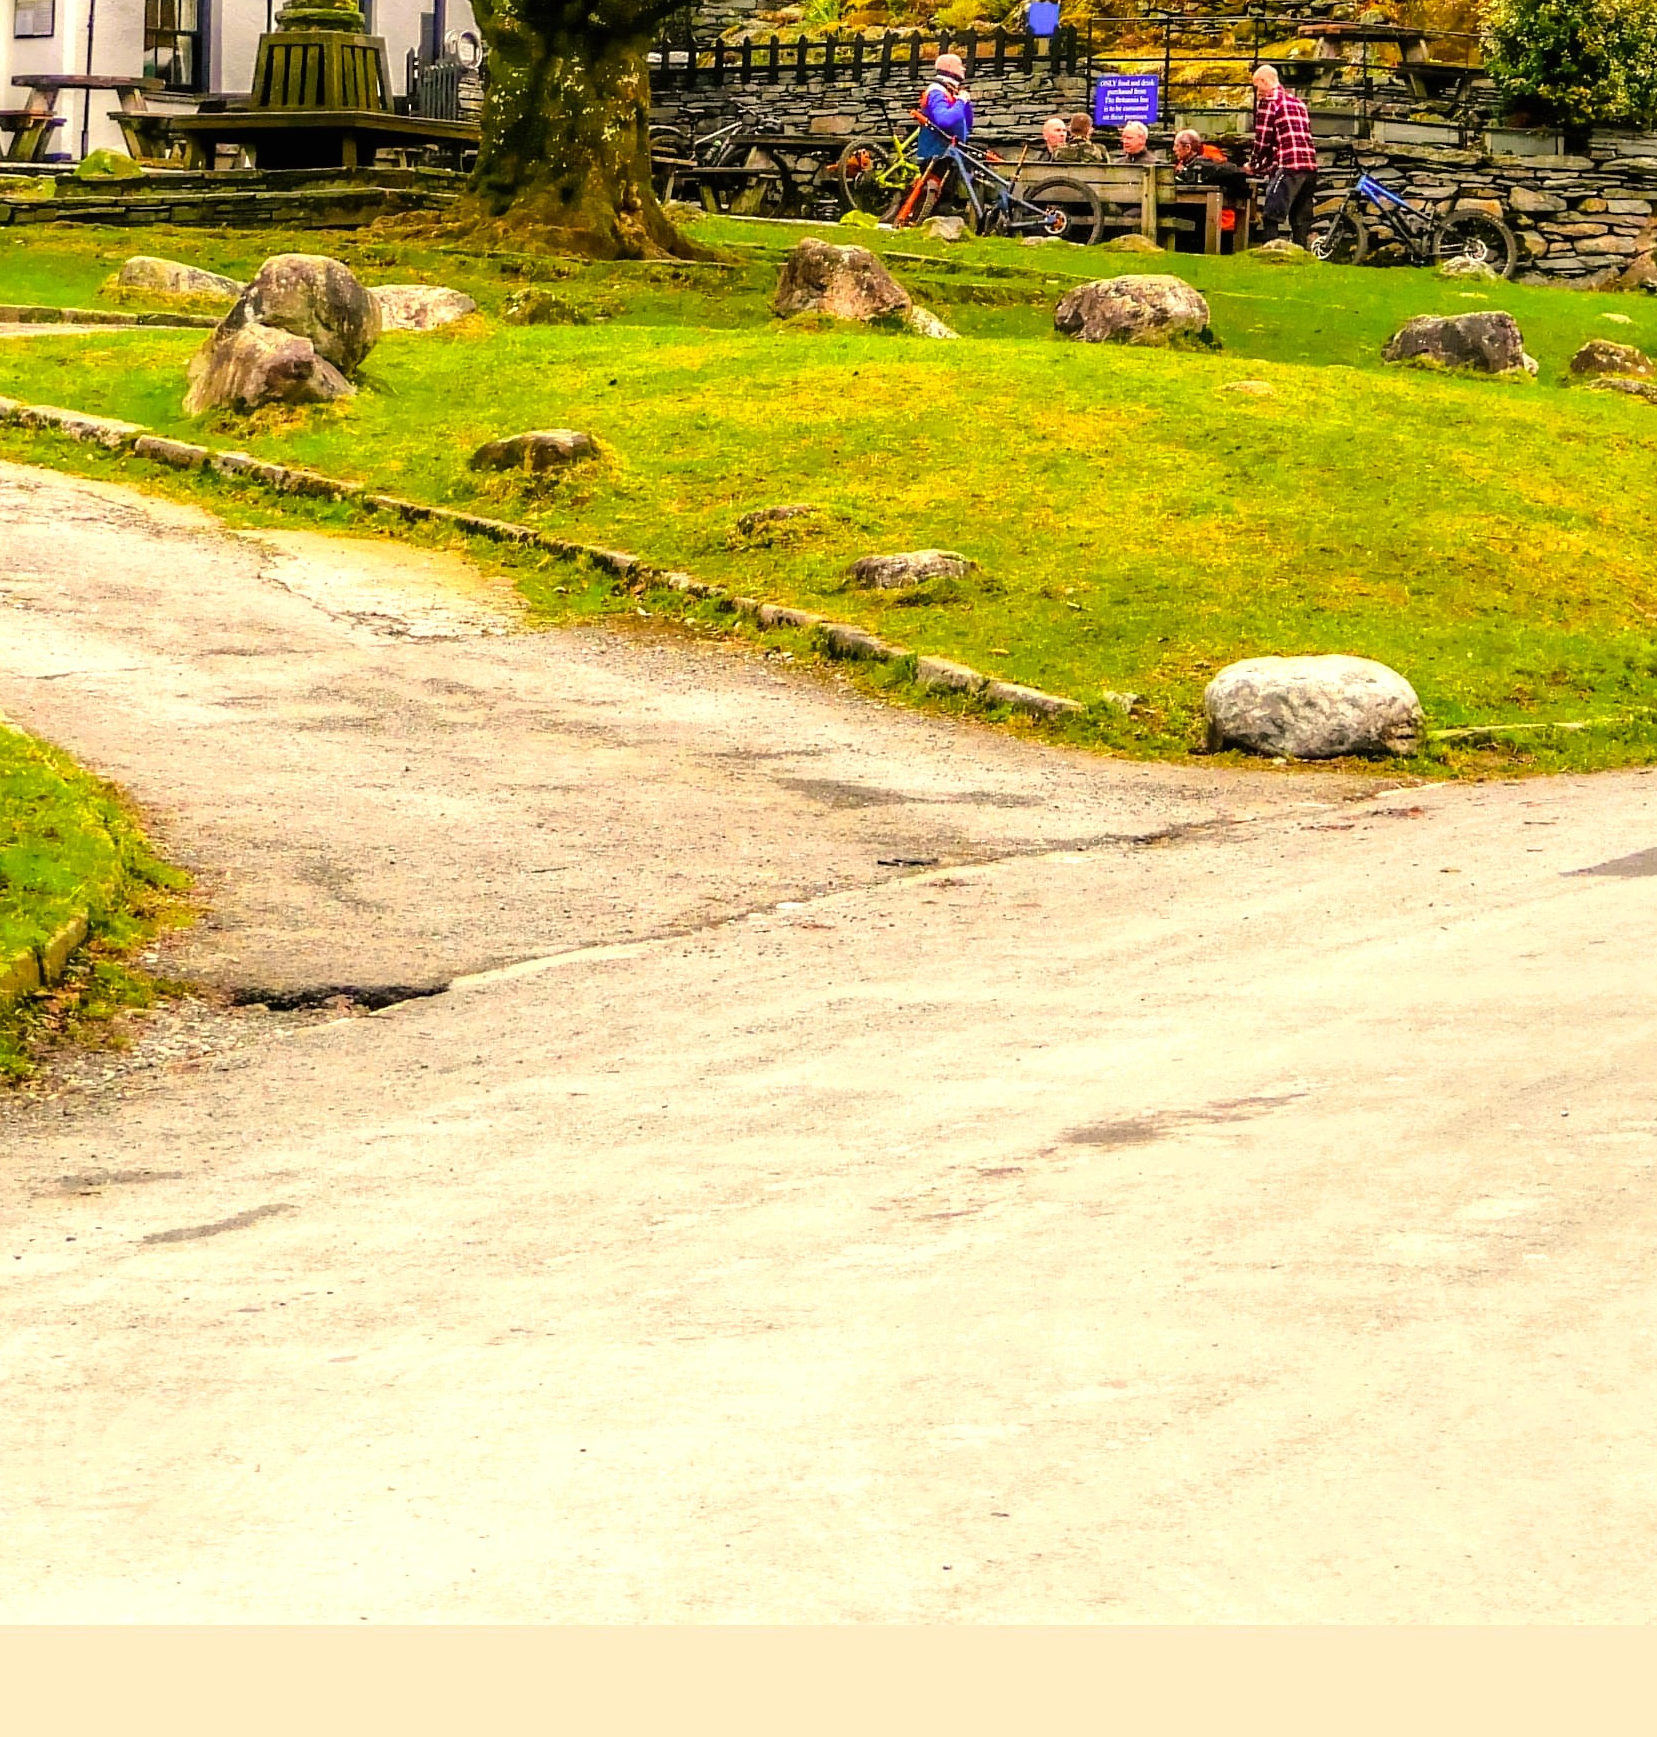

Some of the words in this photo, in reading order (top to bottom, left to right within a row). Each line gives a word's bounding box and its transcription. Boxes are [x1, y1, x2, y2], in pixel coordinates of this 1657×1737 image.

[1100, 79, 1117, 87] ONLY
[1118, 78, 1130, 87] food
[1131, 79, 1141, 87] and
[1141, 78, 1155, 87] drink
[1107, 88, 1133, 97] purchased
